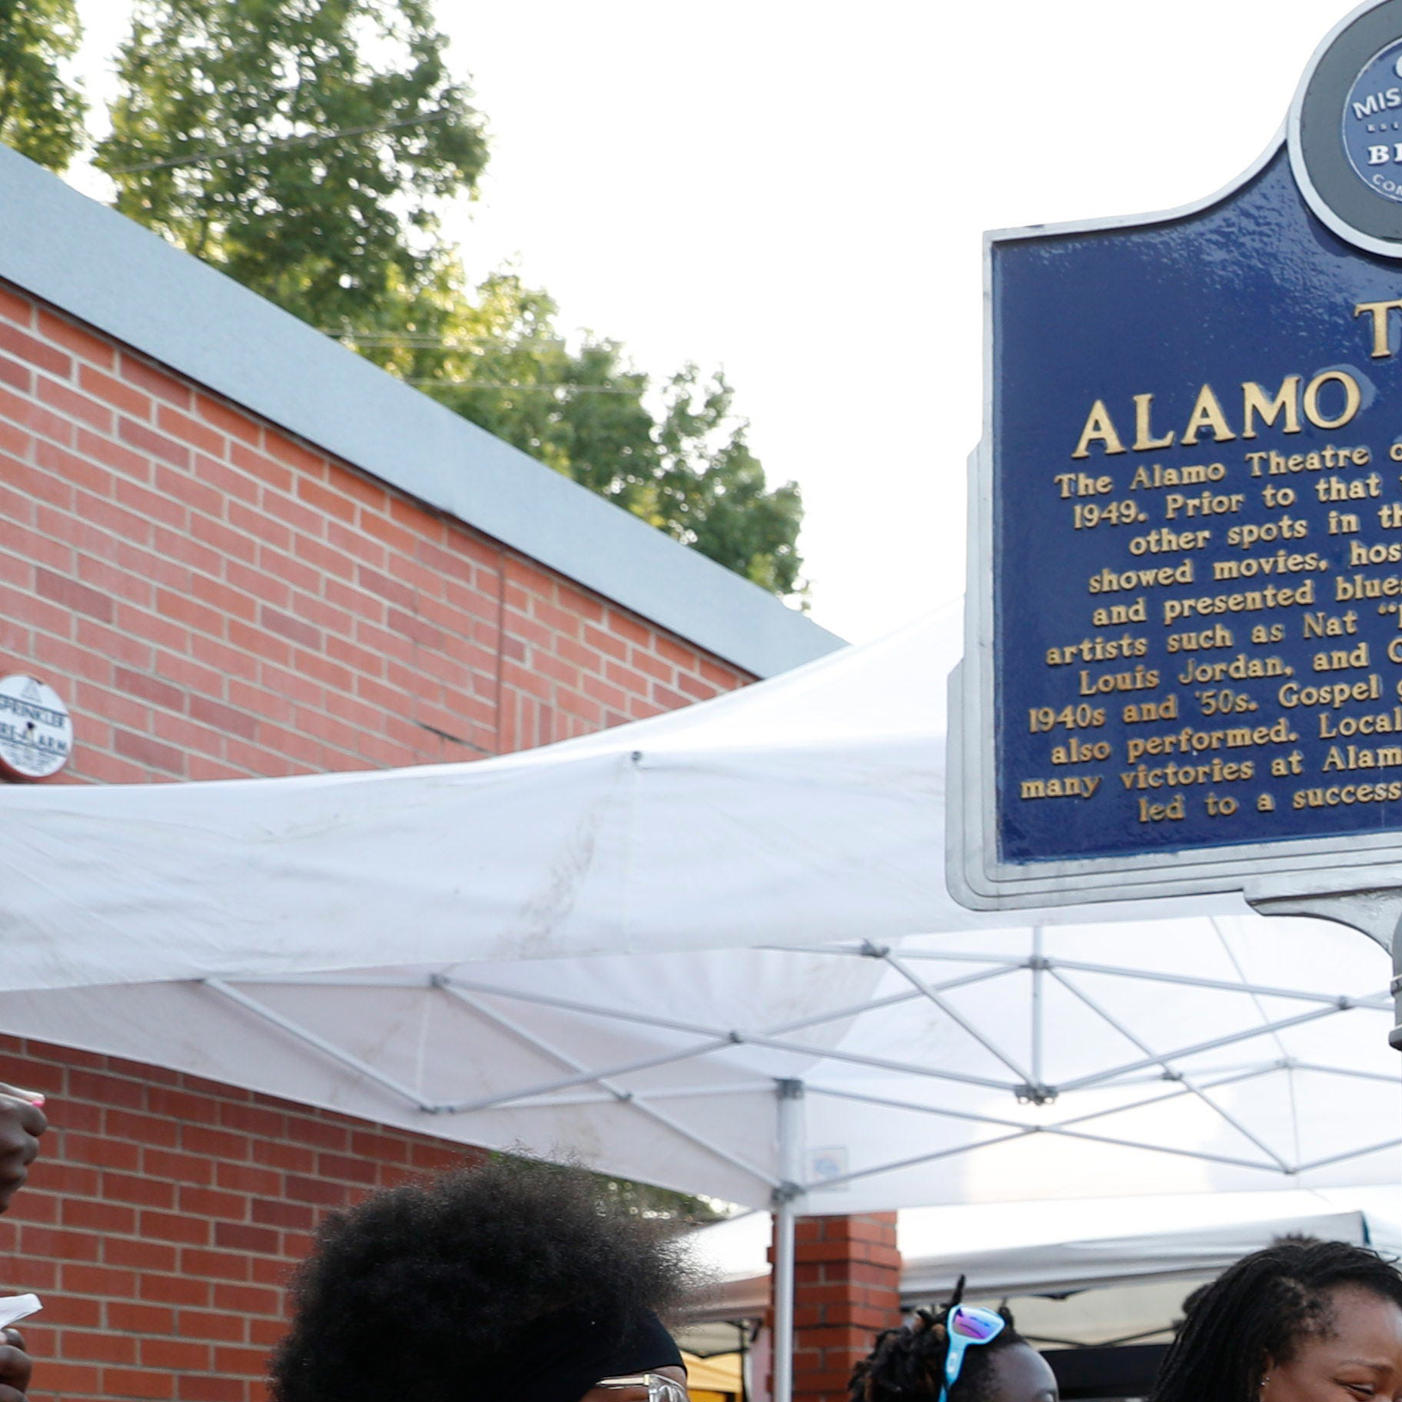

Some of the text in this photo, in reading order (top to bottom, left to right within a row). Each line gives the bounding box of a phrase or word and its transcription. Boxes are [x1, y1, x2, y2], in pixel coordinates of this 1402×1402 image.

[1071, 370, 1361, 459] ALAMO
[1054, 473, 1113, 499] The
[1130, 463, 1227, 491] Alamo
[1244, 445, 1370, 477] Theatre
[1073, 500, 1147, 529] 1949.
[1165, 491, 1244, 520] Prior
[1262, 485, 1296, 508] to
[1315, 474, 1381, 502] that
[1128, 527, 1211, 556] other
[1227, 515, 1308, 550] spots
[1328, 511, 1359, 535] in
[1089, 559, 1193, 594] showed
[1212, 550, 1329, 581] movies,
[1092, 597, 1147, 626] and
[1163, 579, 1315, 626] presented
[1046, 634, 1148, 666] artists
[1167, 623, 1233, 653] such
[1251, 624, 1284, 644] as
[1303, 611, 1358, 639] Nat
[1079, 665, 1160, 696] Louis
[1178, 654, 1294, 684] Jordan,
[1312, 642, 1369, 672] and
[1028, 703, 1106, 734] 1940s
[1122, 694, 1177, 723] and
[1194, 689, 1259, 716] '50s.
[1277, 674, 1380, 709] Gospel
[1050, 737, 1111, 765] also
[1127, 717, 1299, 758] performed.
[1020, 776, 1101, 799] many
[1120, 757, 1254, 790] victories
[1271, 751, 1303, 777] at
[1138, 795, 1185, 823] led
[1205, 794, 1238, 816] to
[1257, 794, 1274, 811] a
